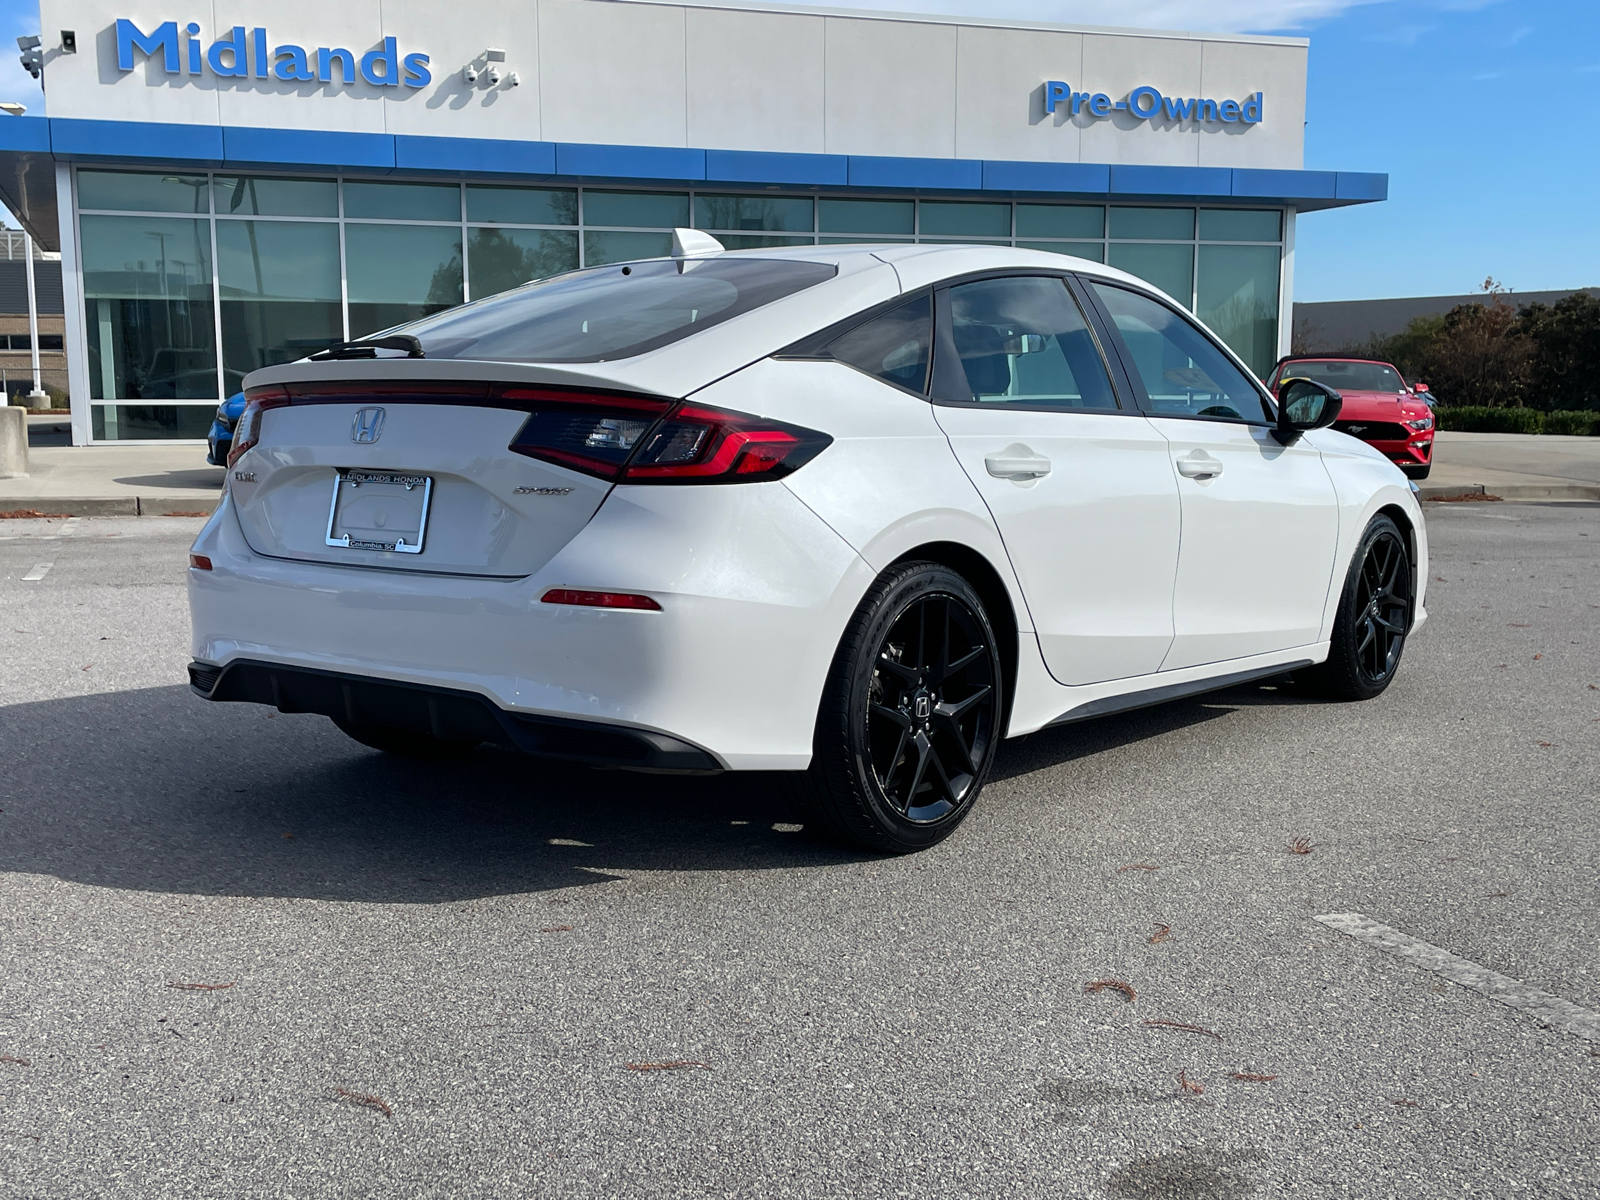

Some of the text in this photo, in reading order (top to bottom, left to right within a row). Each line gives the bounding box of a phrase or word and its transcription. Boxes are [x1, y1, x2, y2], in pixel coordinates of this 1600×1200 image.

[116, 18, 432, 88] Midlands
[1045, 80, 1263, 124] Pre-Owned
[347, 474, 391, 482] MIDLANDS
[512, 485, 576, 496] SPORT
